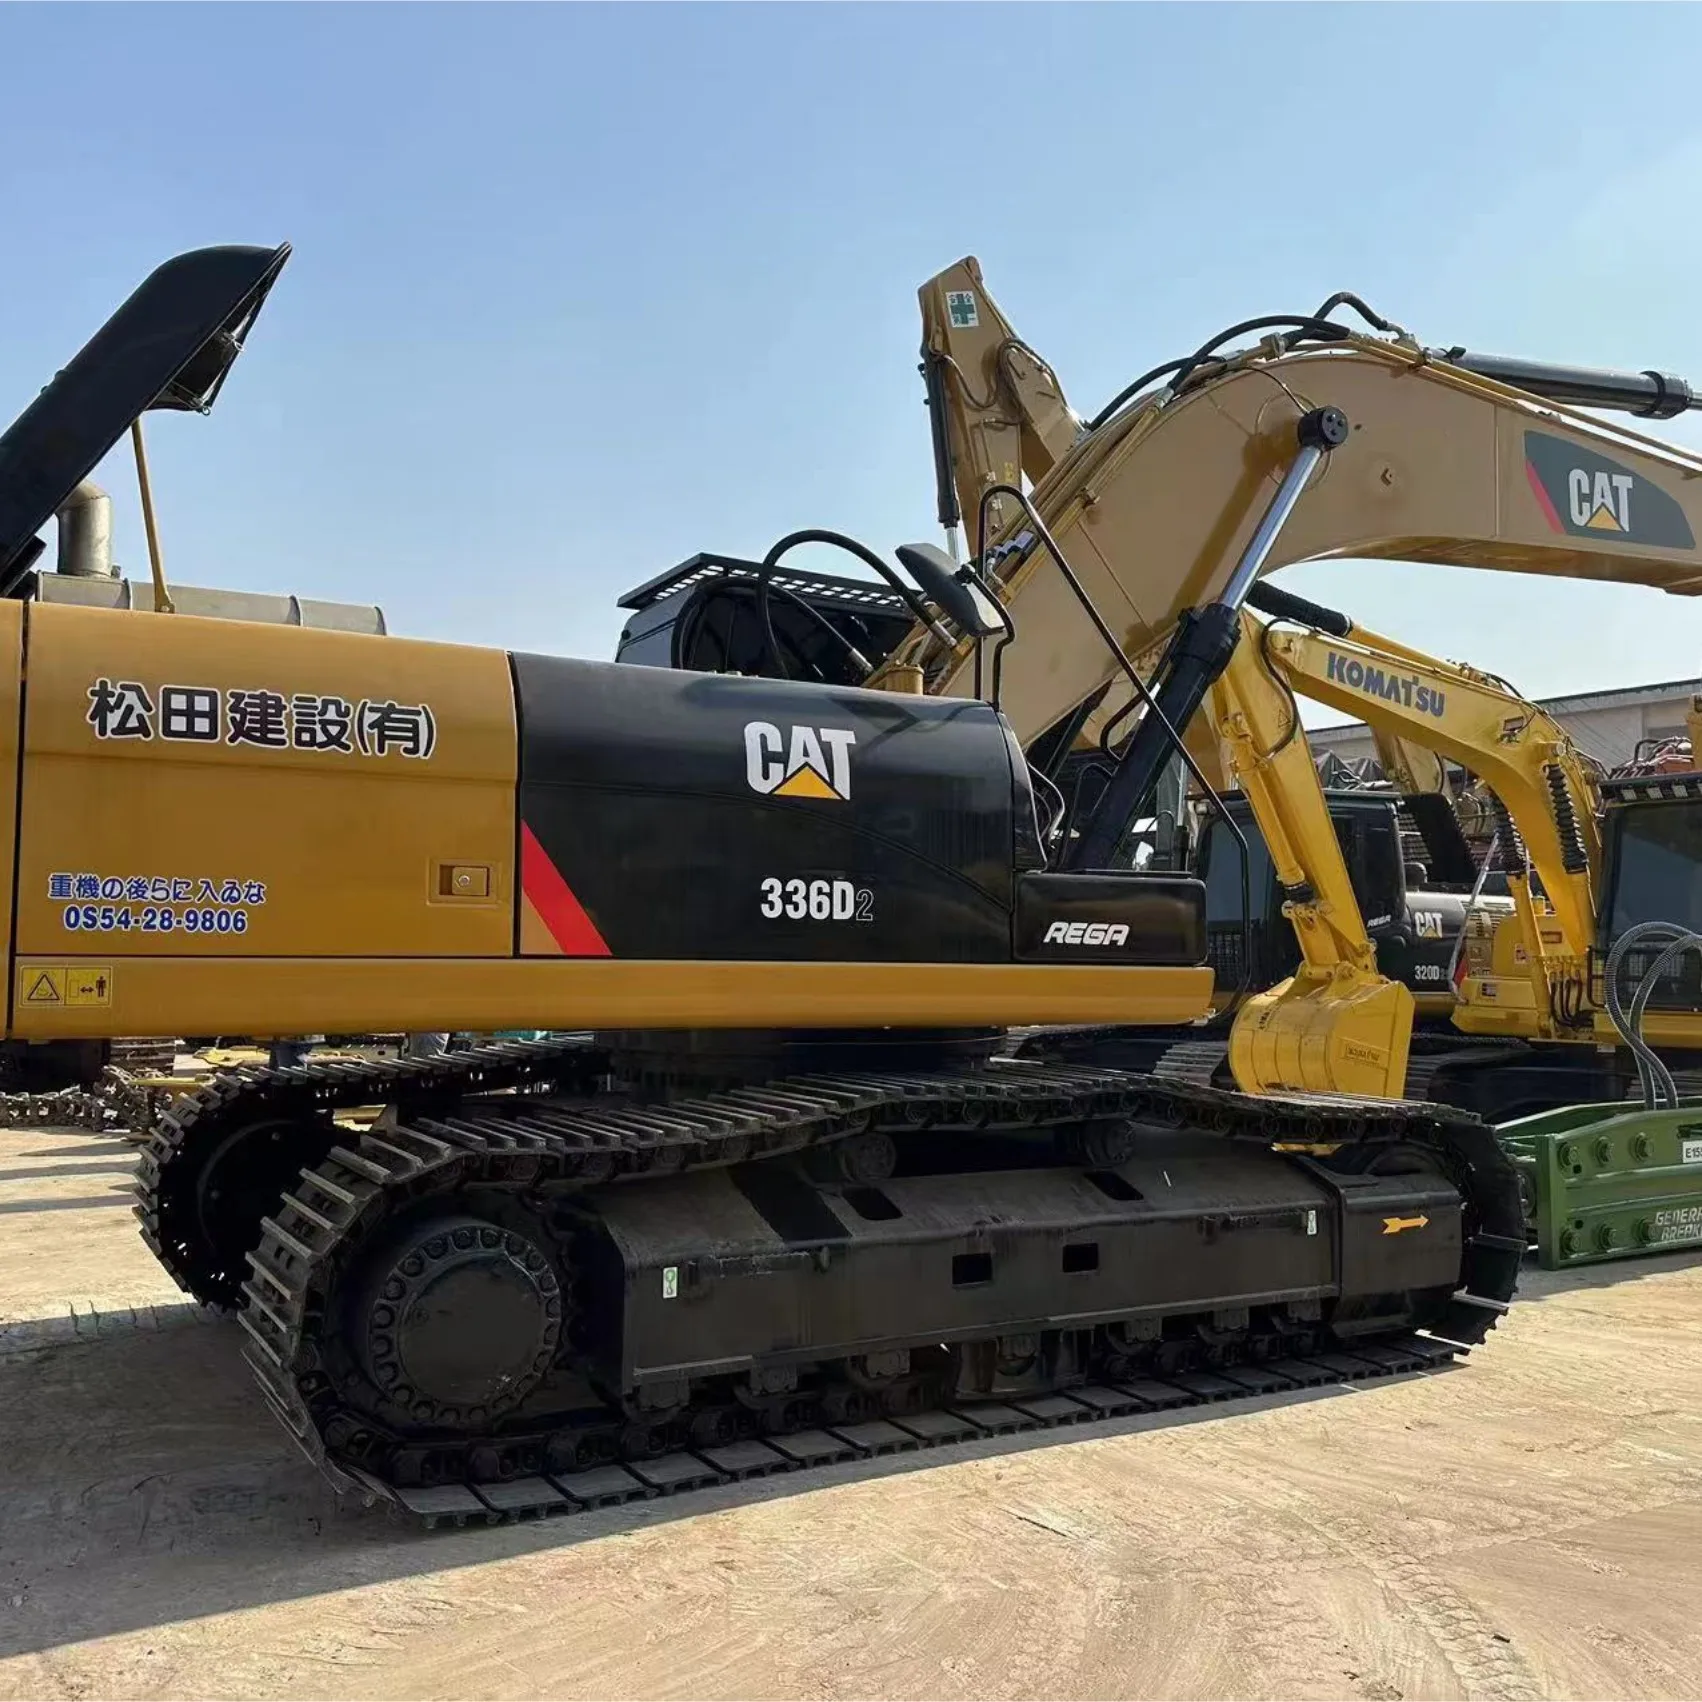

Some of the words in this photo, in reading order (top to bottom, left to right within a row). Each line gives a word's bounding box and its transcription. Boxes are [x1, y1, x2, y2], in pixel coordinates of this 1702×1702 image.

[1569, 468, 1633, 532] CAT
[1326, 651, 1446, 718] KOMATSU
[87, 678, 436, 759] 松田建設(有)
[744, 721, 857, 801] CAT
[1043, 922, 1130, 946] REGA
[1414, 911, 1443, 939] CAT
[1661, 1222, 1702, 1241] BREAK
